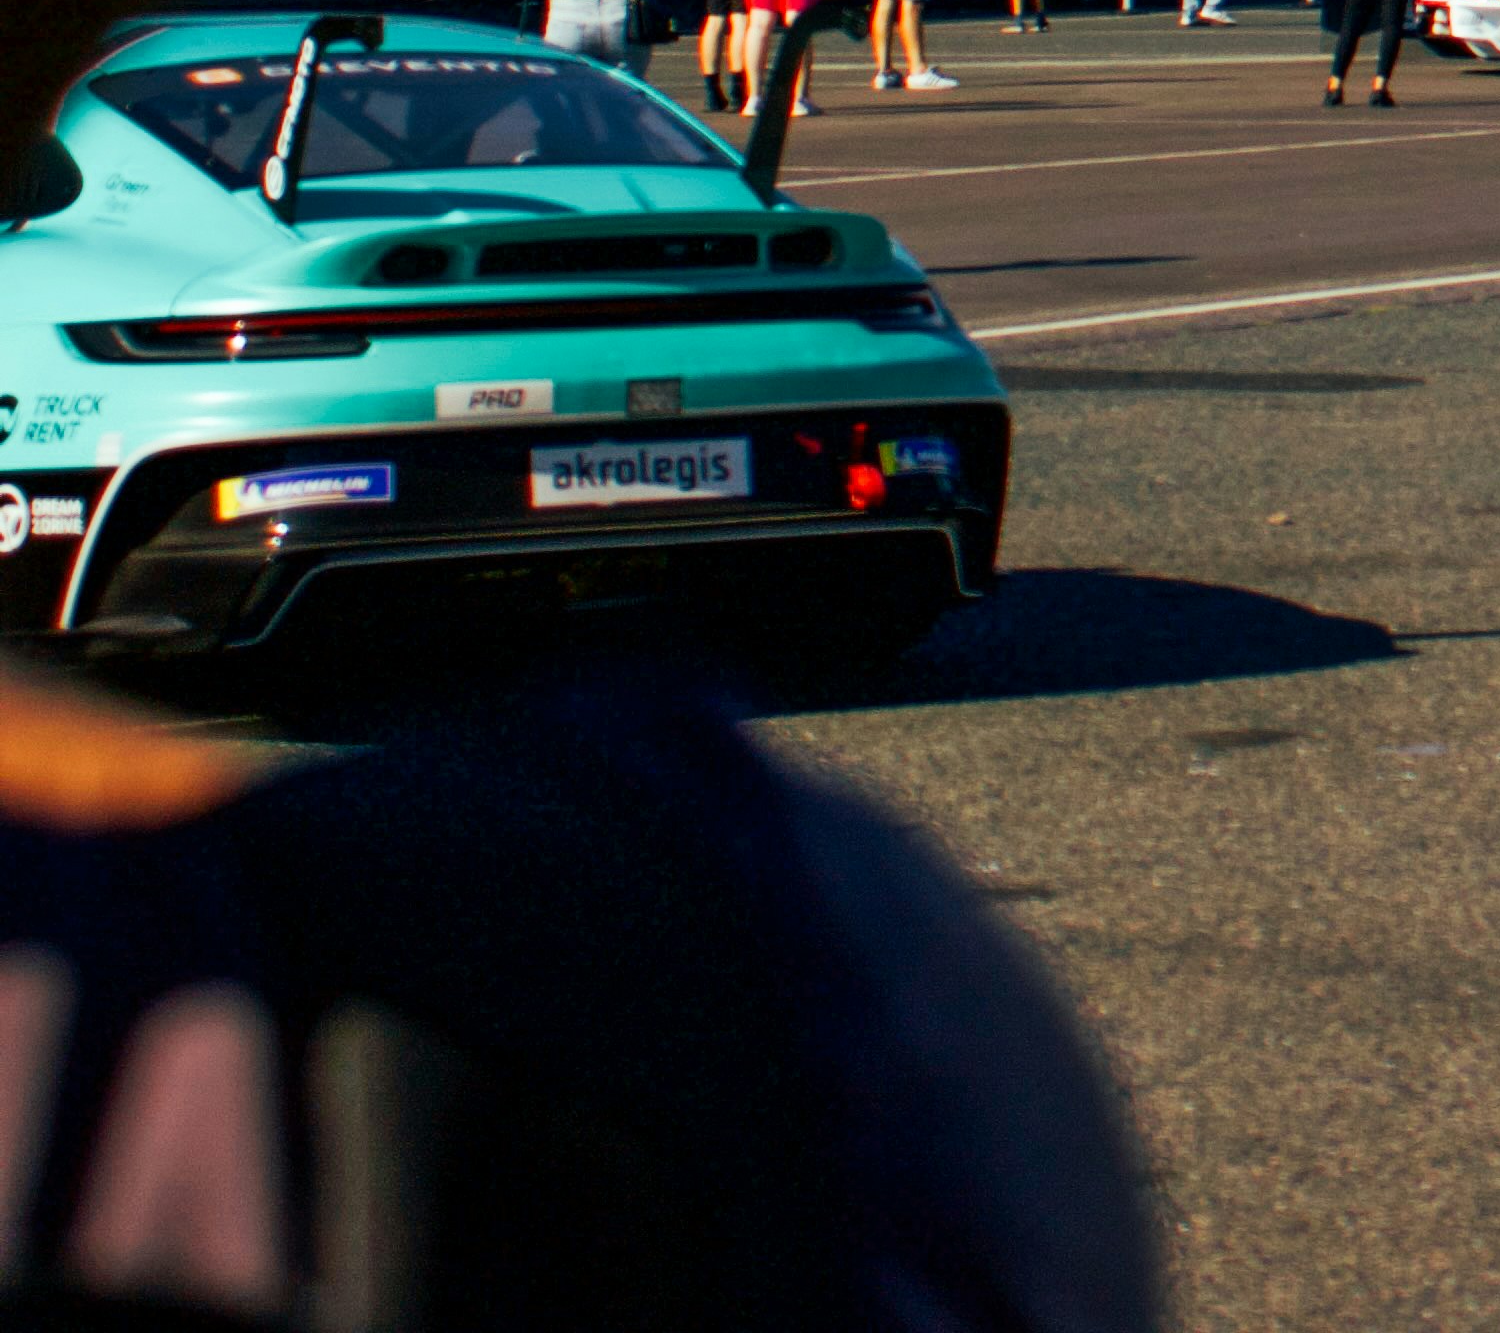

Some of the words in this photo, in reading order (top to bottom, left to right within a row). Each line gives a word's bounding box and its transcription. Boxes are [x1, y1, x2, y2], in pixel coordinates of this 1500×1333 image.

[34, 395, 105, 416] TRUCK
[469, 388, 526, 408] PRO
[24, 421, 81, 443] RENT
[552, 449, 731, 492] akrolegis
